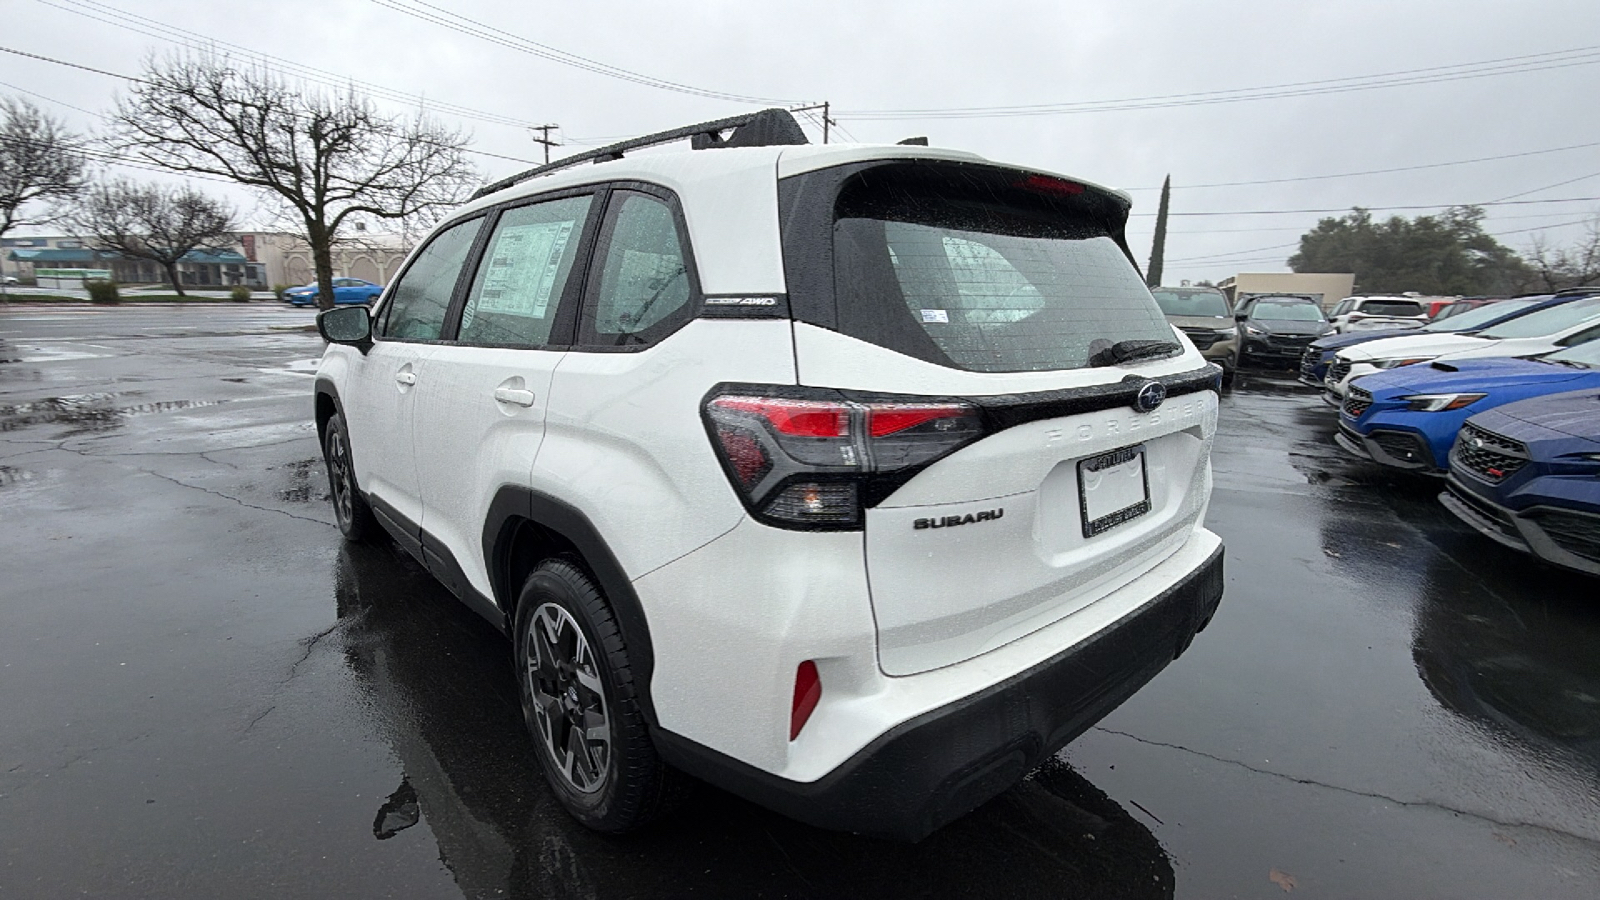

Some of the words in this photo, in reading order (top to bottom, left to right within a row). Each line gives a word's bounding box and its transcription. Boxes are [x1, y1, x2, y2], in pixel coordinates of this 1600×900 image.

[740, 297, 776, 306] AWD
[1045, 399, 1204, 447] FORESTER
[913, 507, 1004, 530] SUBARU
